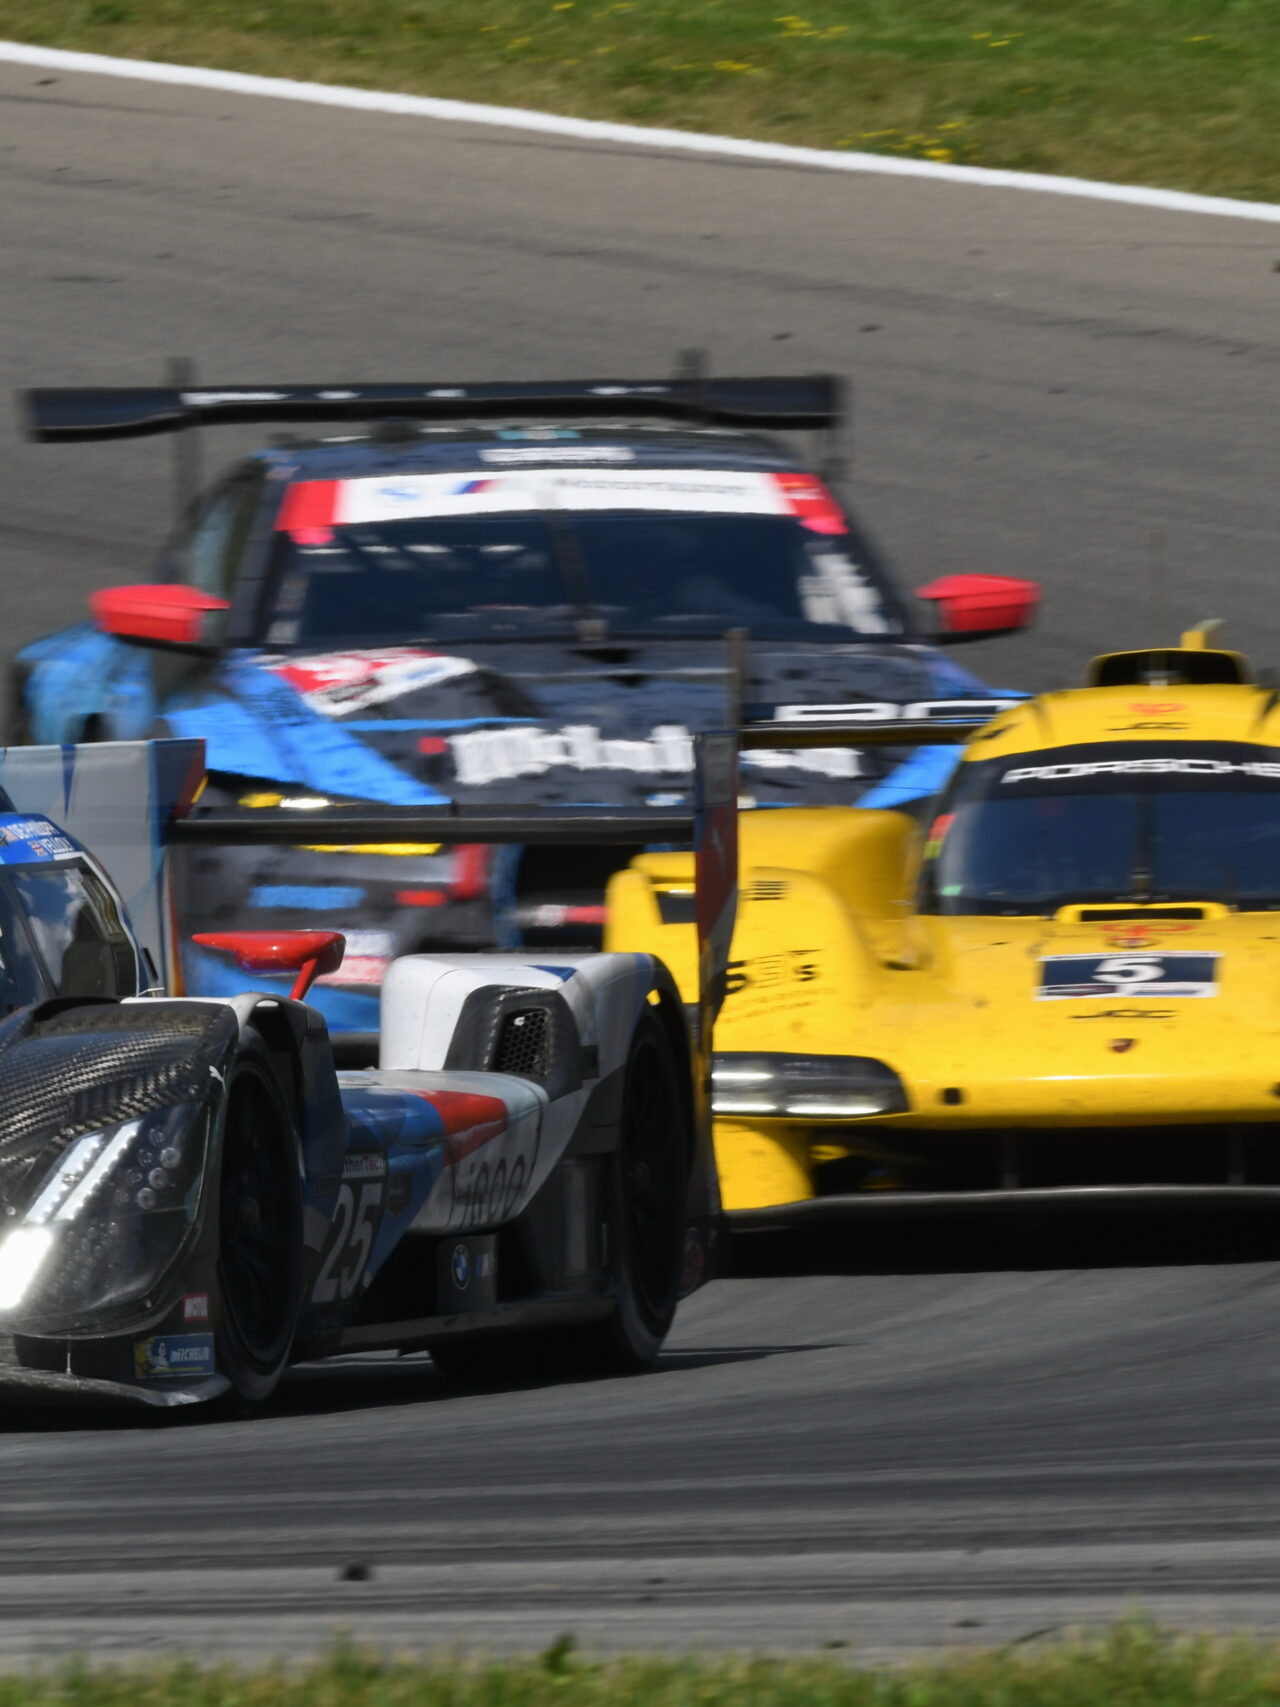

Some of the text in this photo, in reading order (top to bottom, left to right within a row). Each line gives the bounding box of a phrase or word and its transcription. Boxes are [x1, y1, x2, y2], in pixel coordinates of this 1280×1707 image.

[1001, 758, 1280, 783] PORSCHE
[1091, 956, 1166, 984] 5
[311, 1182, 383, 1303] 25
